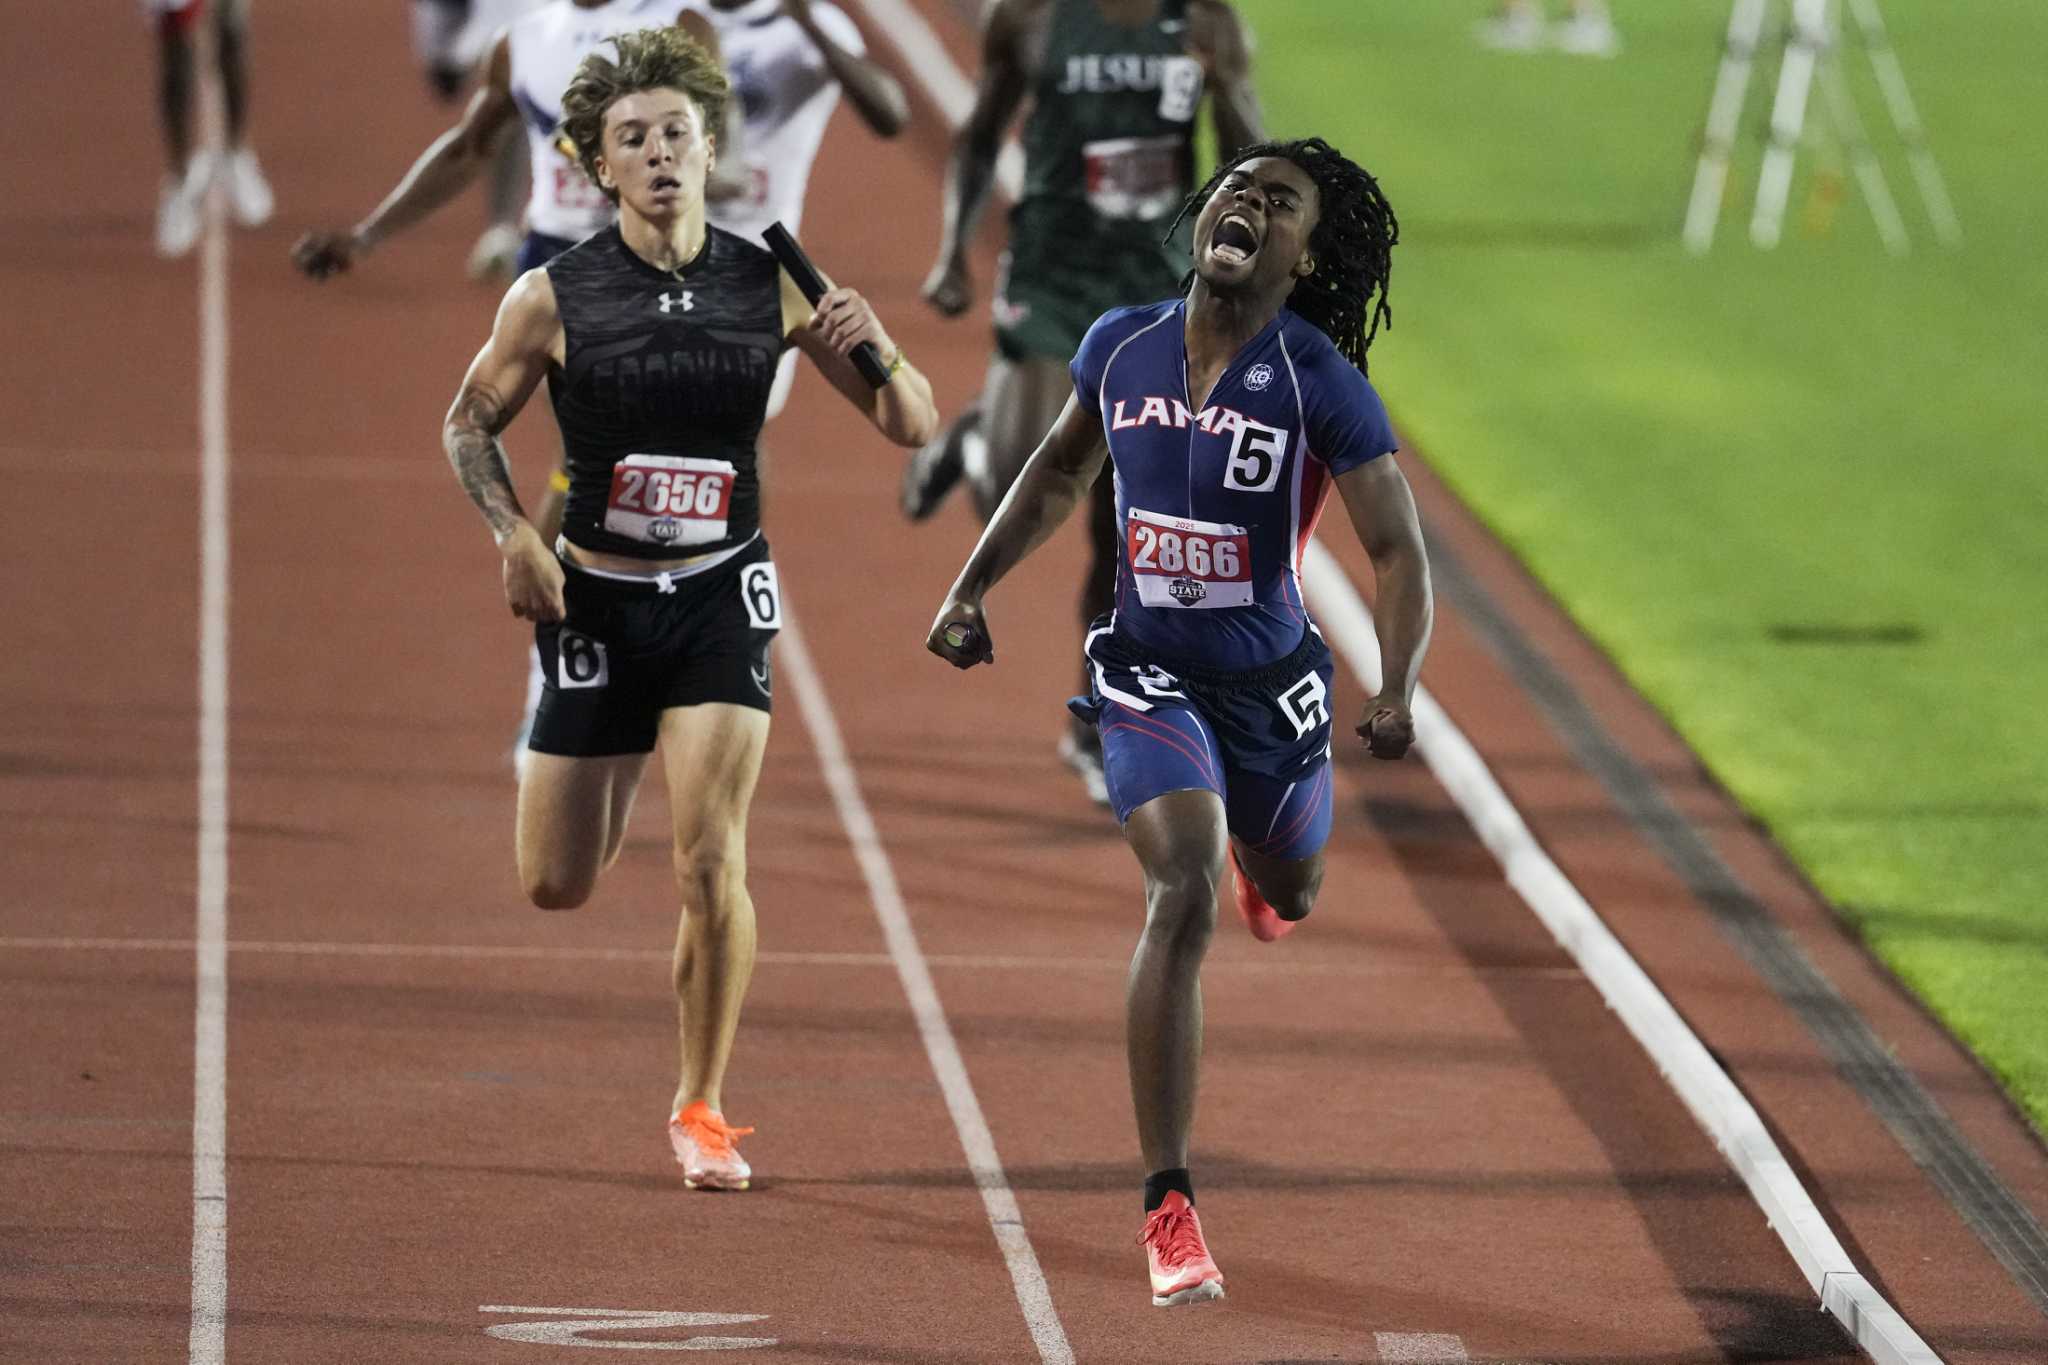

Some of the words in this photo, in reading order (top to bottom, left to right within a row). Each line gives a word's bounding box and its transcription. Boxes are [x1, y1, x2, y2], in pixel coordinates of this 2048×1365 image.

[1112, 397, 1260, 434] LAMA
[1233, 427, 1275, 487] 5
[618, 470, 723, 515] 2656
[1134, 526, 1240, 578] 2866
[748, 569, 775, 623] 6
[1169, 585, 1206, 597] STATE
